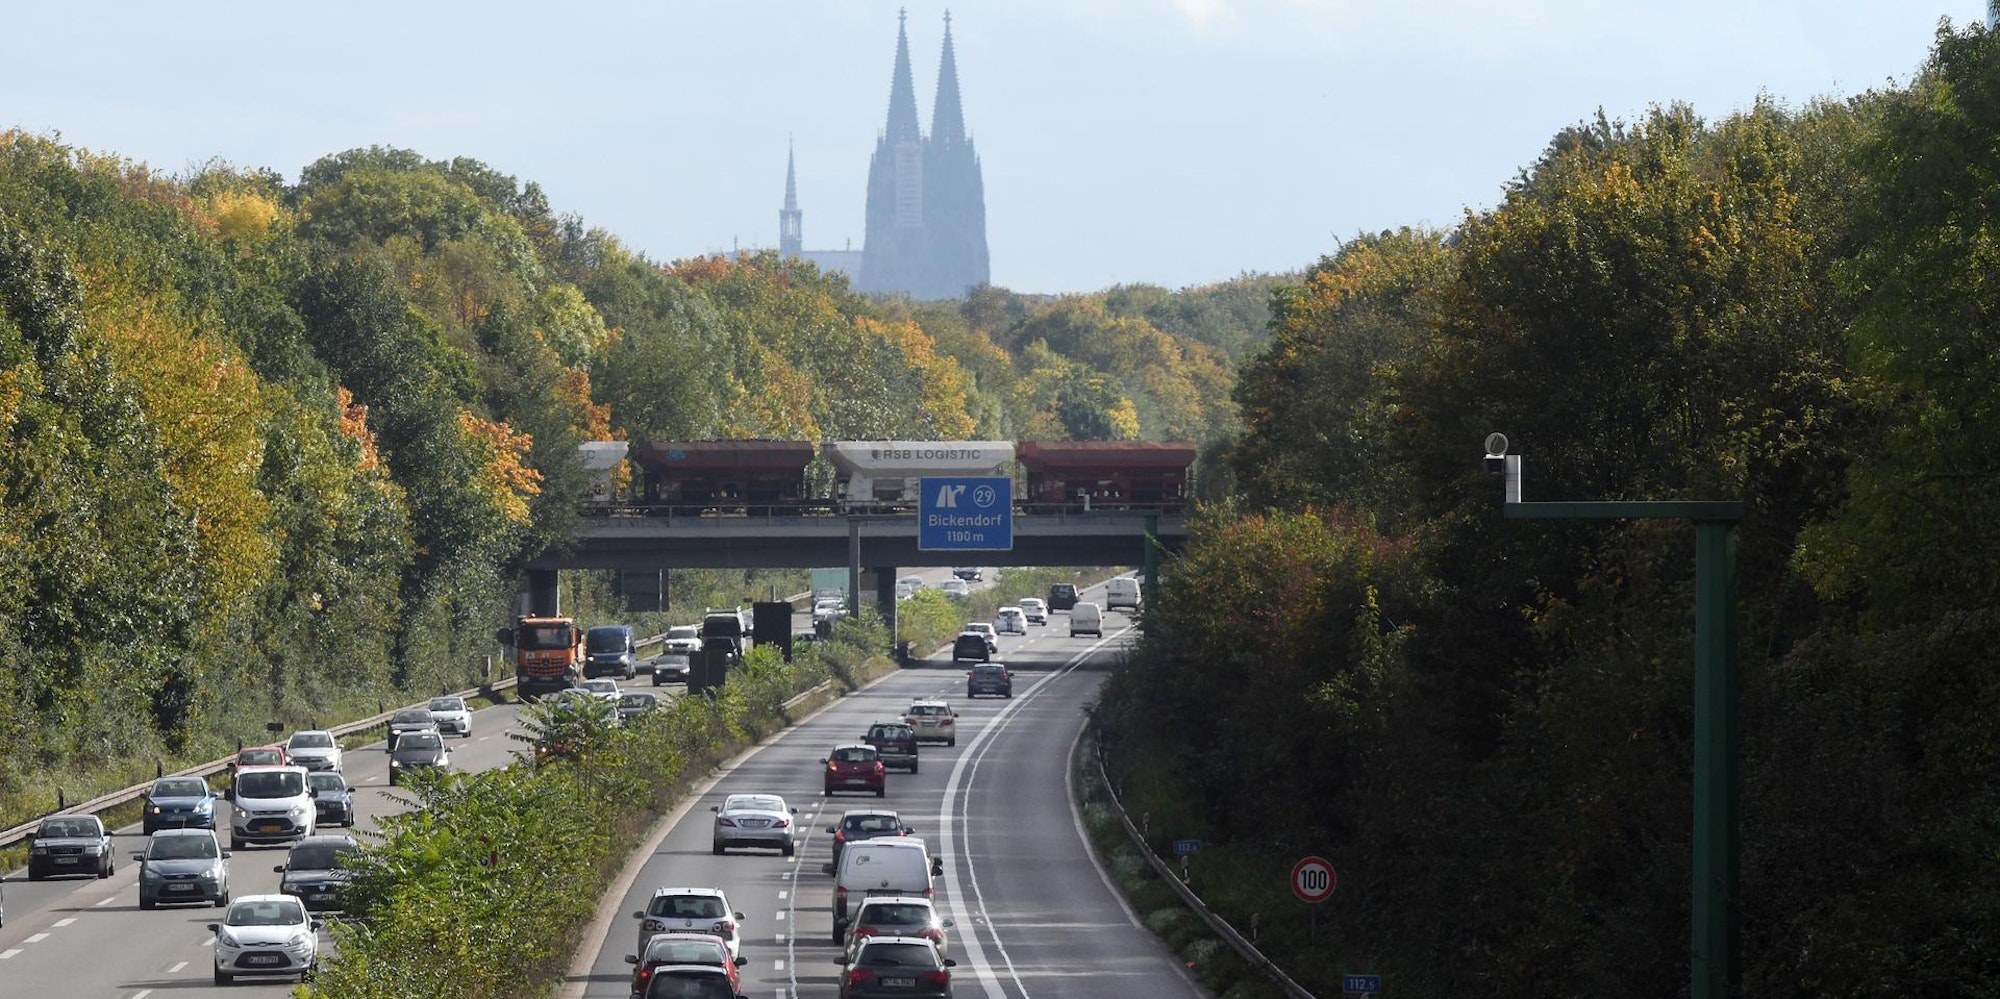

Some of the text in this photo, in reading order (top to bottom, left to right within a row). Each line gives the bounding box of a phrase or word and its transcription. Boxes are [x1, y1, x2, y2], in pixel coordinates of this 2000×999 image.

[883, 449, 981, 460] RSB LOGISTIC
[976, 490, 991, 503] 29
[928, 514, 1002, 527] Bickendorf
[947, 531, 984, 542] 1100 m
[1300, 869, 1327, 890] 100
